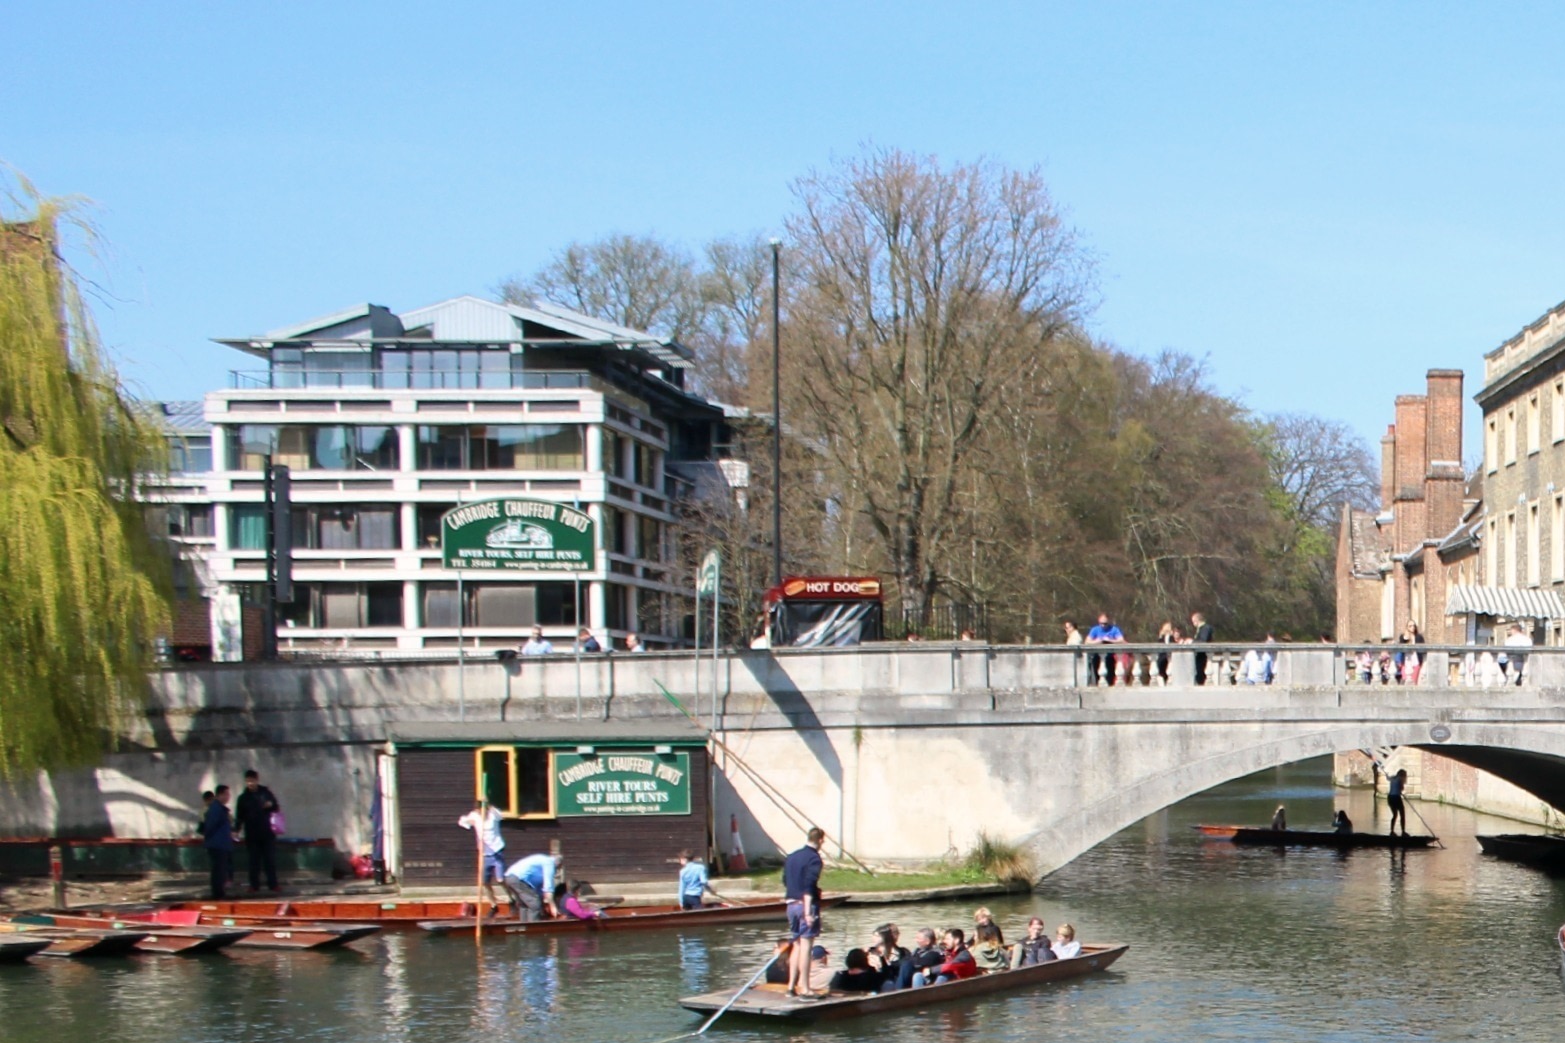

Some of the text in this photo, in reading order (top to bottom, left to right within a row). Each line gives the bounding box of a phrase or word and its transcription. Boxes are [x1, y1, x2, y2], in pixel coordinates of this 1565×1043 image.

[446, 501, 592, 533] CAMBRIDGE CHAUFFEUR PUNTS
[458, 549, 484, 558] RIVER
[514, 550, 534, 559] SELF
[535, 550, 555, 559] HIRE
[556, 550, 582, 561] PUNTS
[450, 558, 468, 568] TEL
[806, 582, 829, 593] HOT
[558, 756, 684, 787] CAMBRIDGE CHAUFFEUR PUNTS
[588, 780, 657, 792] RIVER TOURS
[576, 791, 669, 804] SELF HIRE PUNTS
